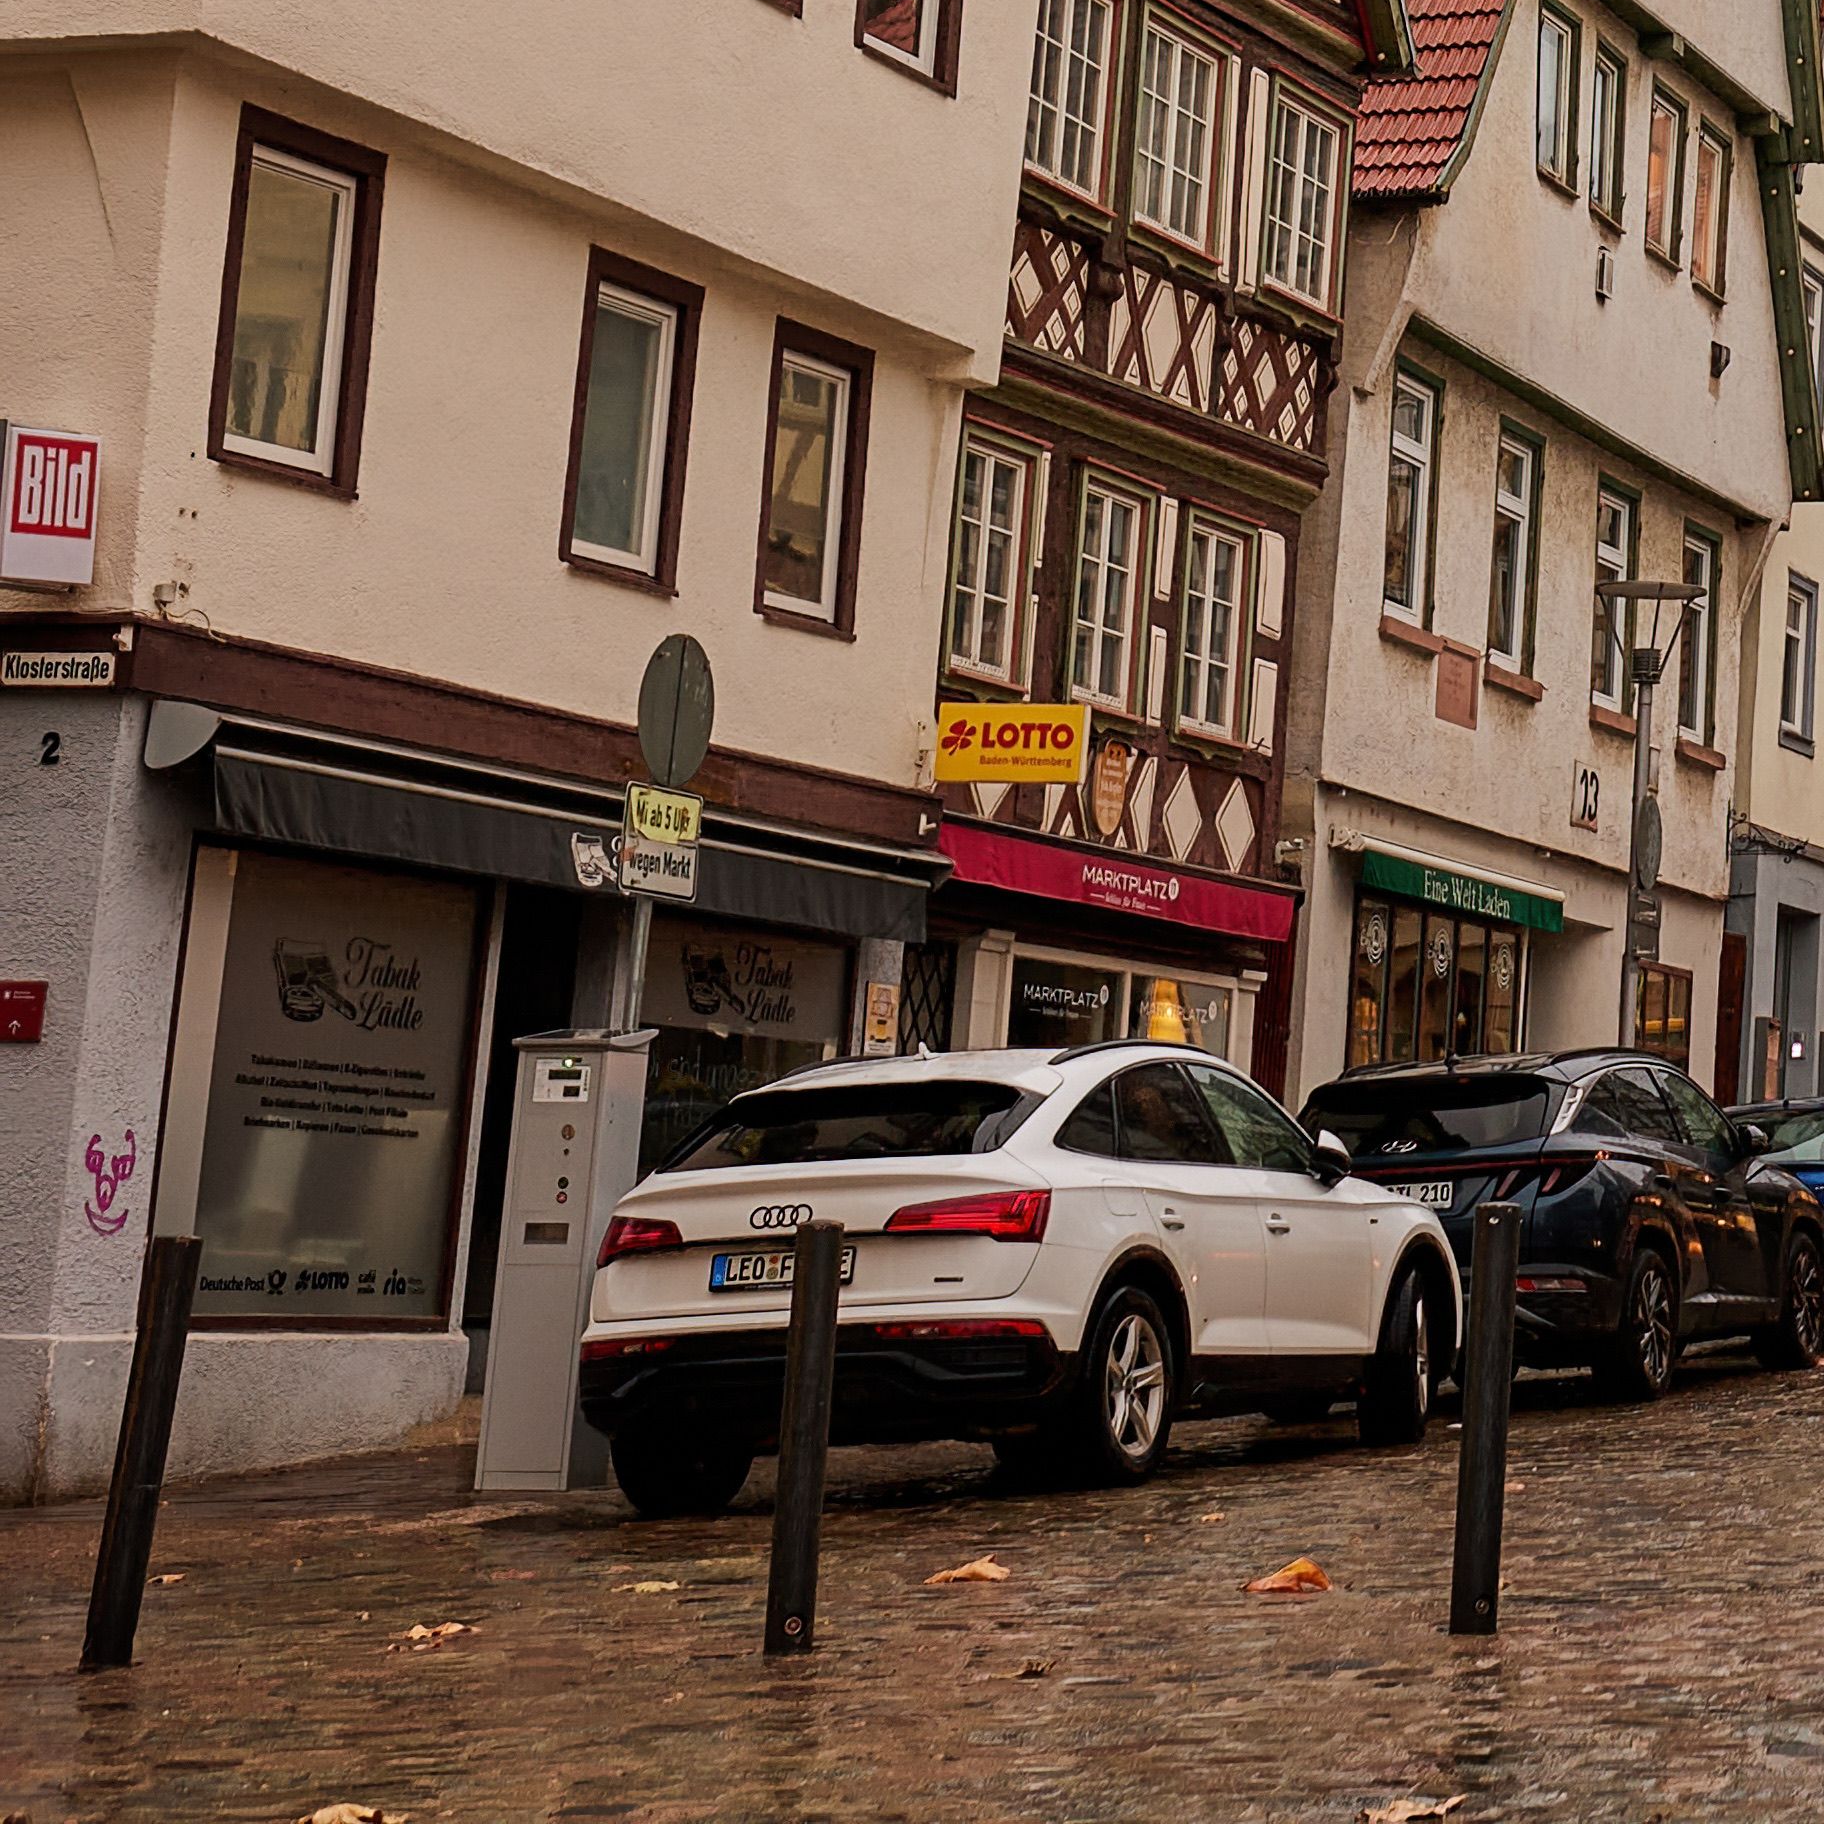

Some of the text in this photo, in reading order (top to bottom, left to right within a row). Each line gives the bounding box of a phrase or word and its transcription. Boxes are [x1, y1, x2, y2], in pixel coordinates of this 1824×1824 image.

[18, 444, 91, 530] Bild
[5, 654, 110, 683] Klosterstraße
[40, 731, 61, 766] 2
[981, 722, 1075, 750] LOTTO
[979, 754, 1072, 769] Baden-Württemberg
[1580, 768, 1599, 822] 13
[650, 804, 663, 828] ab
[664, 805, 672, 830] 5
[662, 851, 691, 880] Markt
[1082, 864, 1168, 900] MARKTPLATZ
[1423, 869, 1511, 919] Eine Welt Laden
[344, 937, 421, 990] Tabak
[734, 942, 795, 990] Tabak
[745, 989, 796, 1024] Lädle
[1023, 983, 1099, 1009] MARKTPLATZ
[356, 990, 423, 1032] Lädle
[1139, 1000, 1209, 1024] MARKTPLATZ
[1420, 1184, 1450, 1203] 210
[199, 1275, 265, 1292] Deutsche Post
[311, 1270, 349, 1290] LOTTO
[382, 1268, 406, 1295] ria
[725, 1256, 766, 1282] LEO
